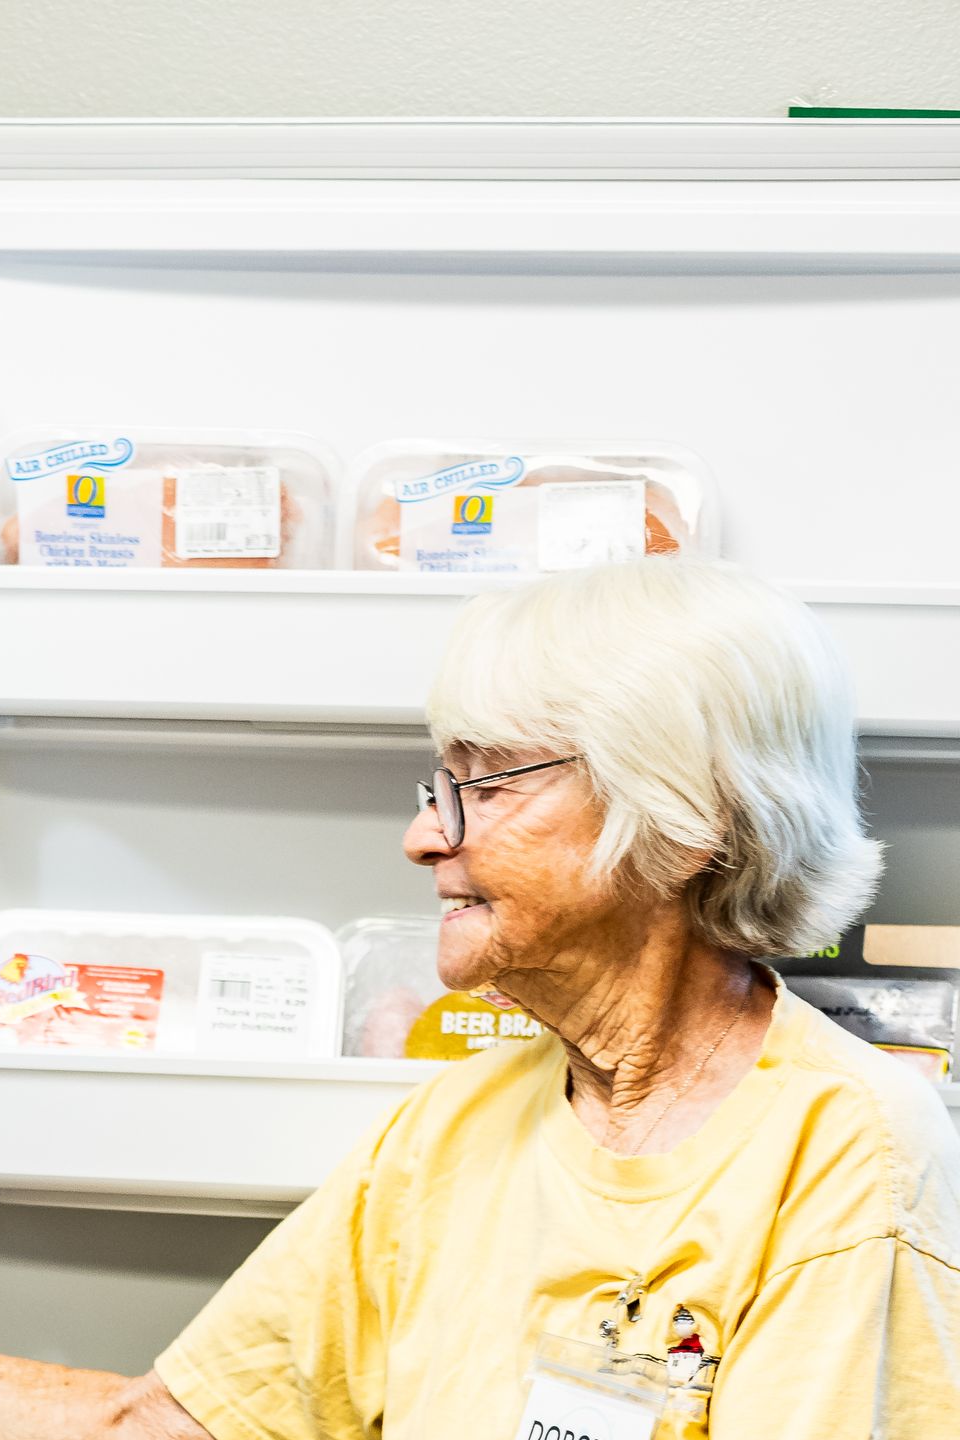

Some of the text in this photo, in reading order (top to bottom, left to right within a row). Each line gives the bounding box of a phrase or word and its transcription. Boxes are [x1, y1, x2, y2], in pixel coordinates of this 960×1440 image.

[15, 443, 110, 473] AIR CHILLED
[402, 463, 500, 496] AIR CHILLED
[34, 530, 140, 544] Boneless Skinless
[40, 544, 85, 557] Chicken
[215, 1006, 297, 1021] Thank you for
[210, 1022, 237, 1032] your
[441, 1011, 550, 1037] BEER BRA
